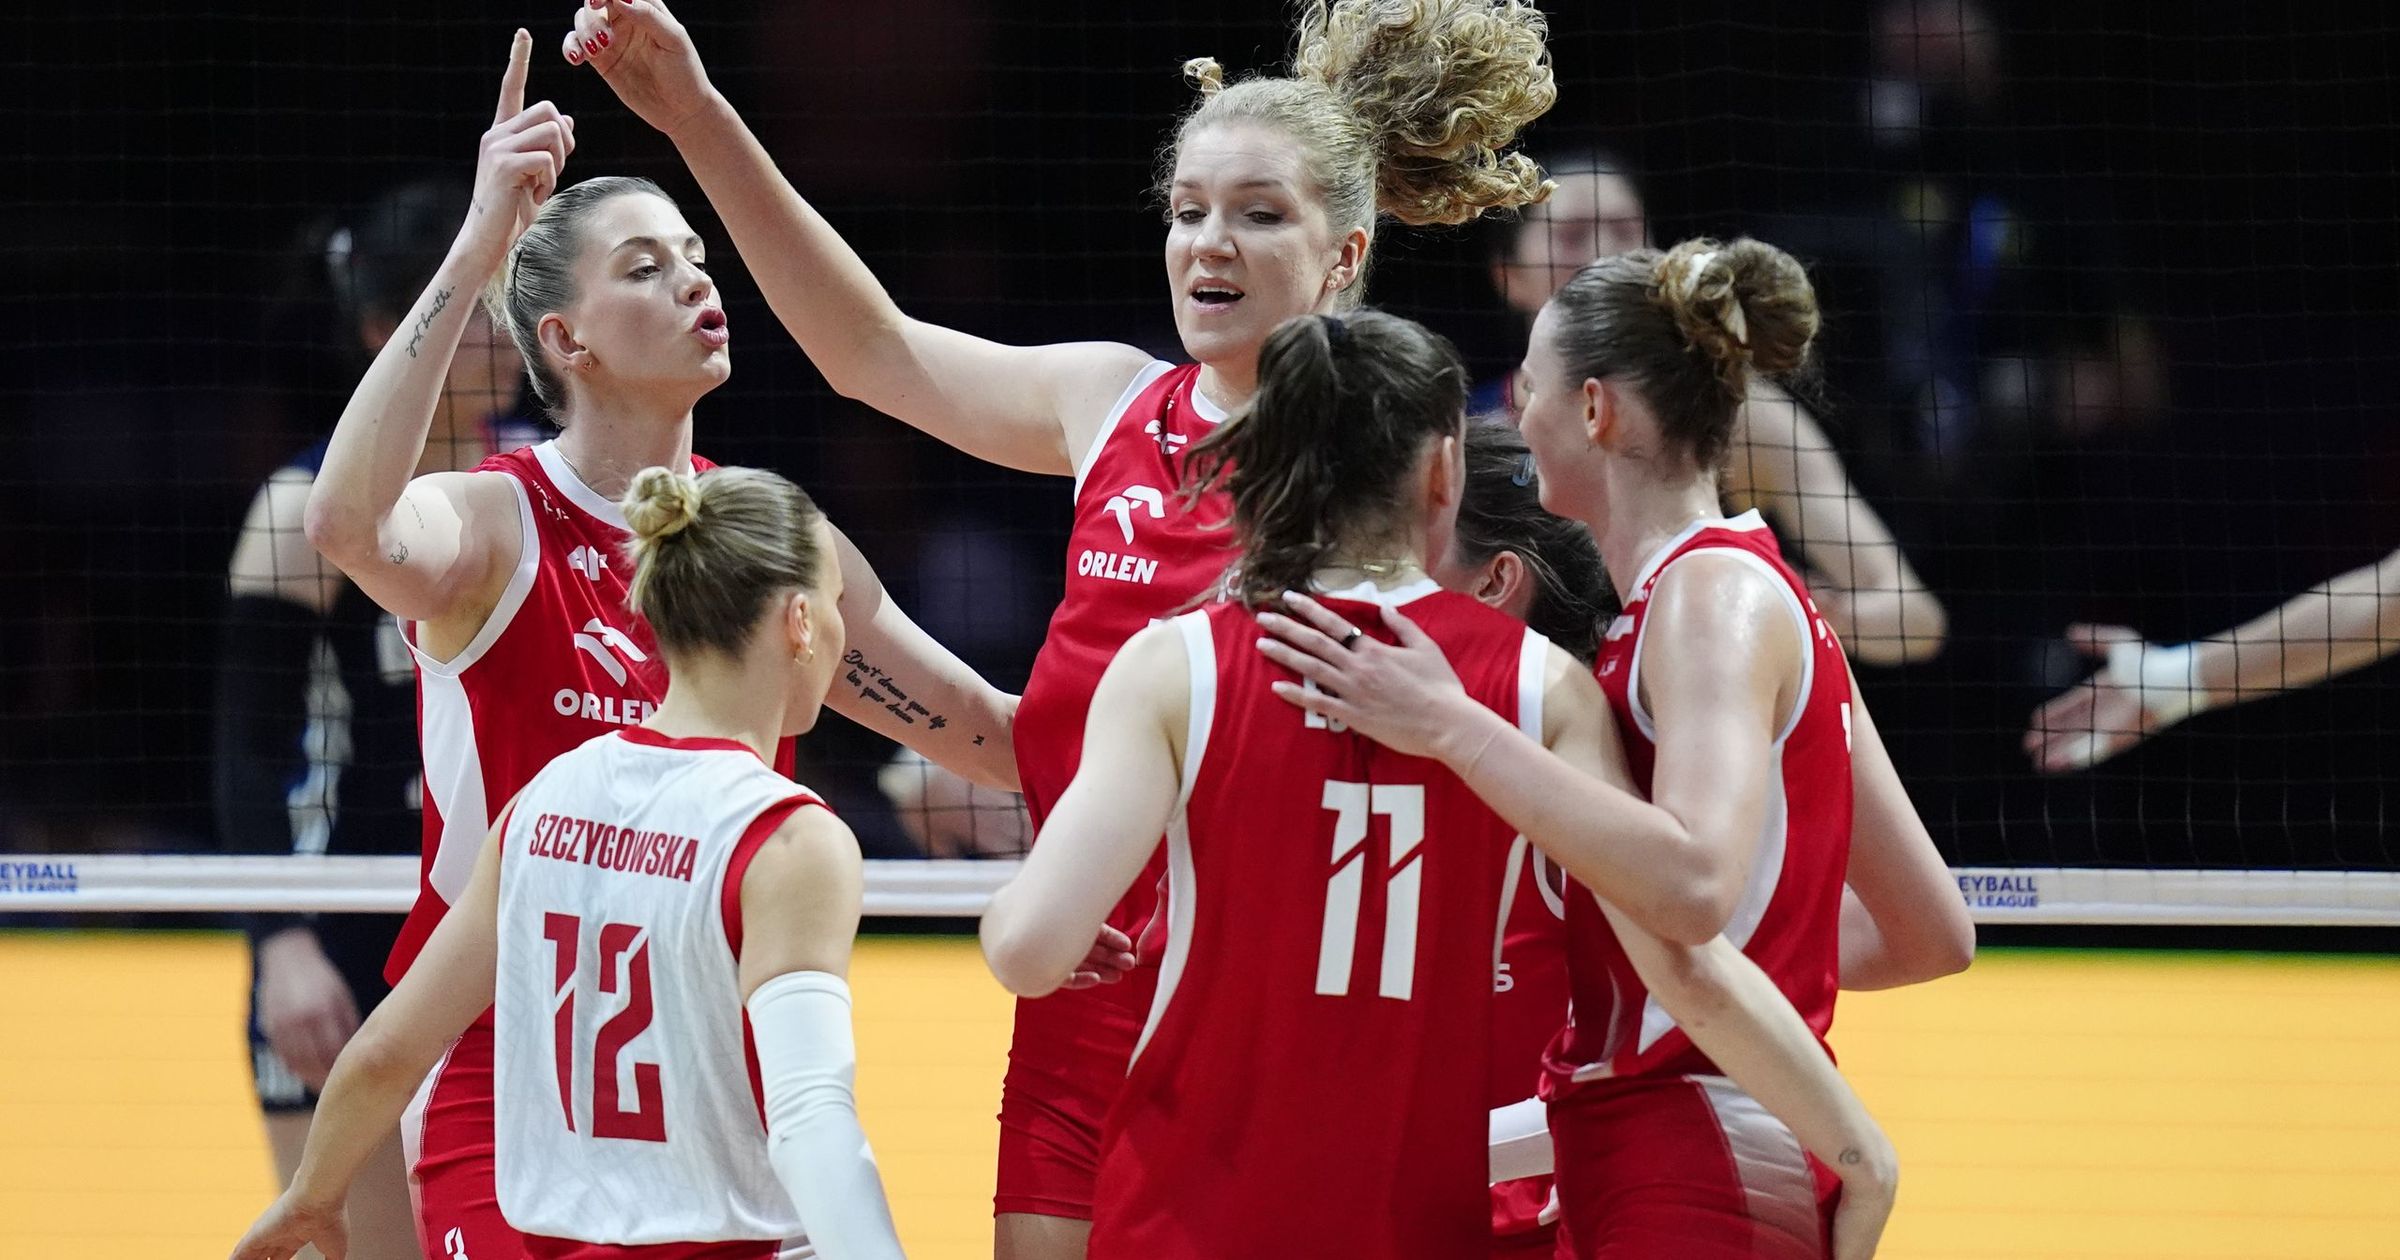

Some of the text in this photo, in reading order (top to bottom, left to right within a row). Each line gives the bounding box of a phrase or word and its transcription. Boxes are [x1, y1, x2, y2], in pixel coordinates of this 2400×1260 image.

[1078, 550, 1158, 585] ORLEN
[529, 813, 699, 882] SZCZYGOWSKA
[1315, 779, 1425, 1001] 11
[1977, 895, 2039, 907] LEAGUE
[544, 911, 667, 1142] 12
